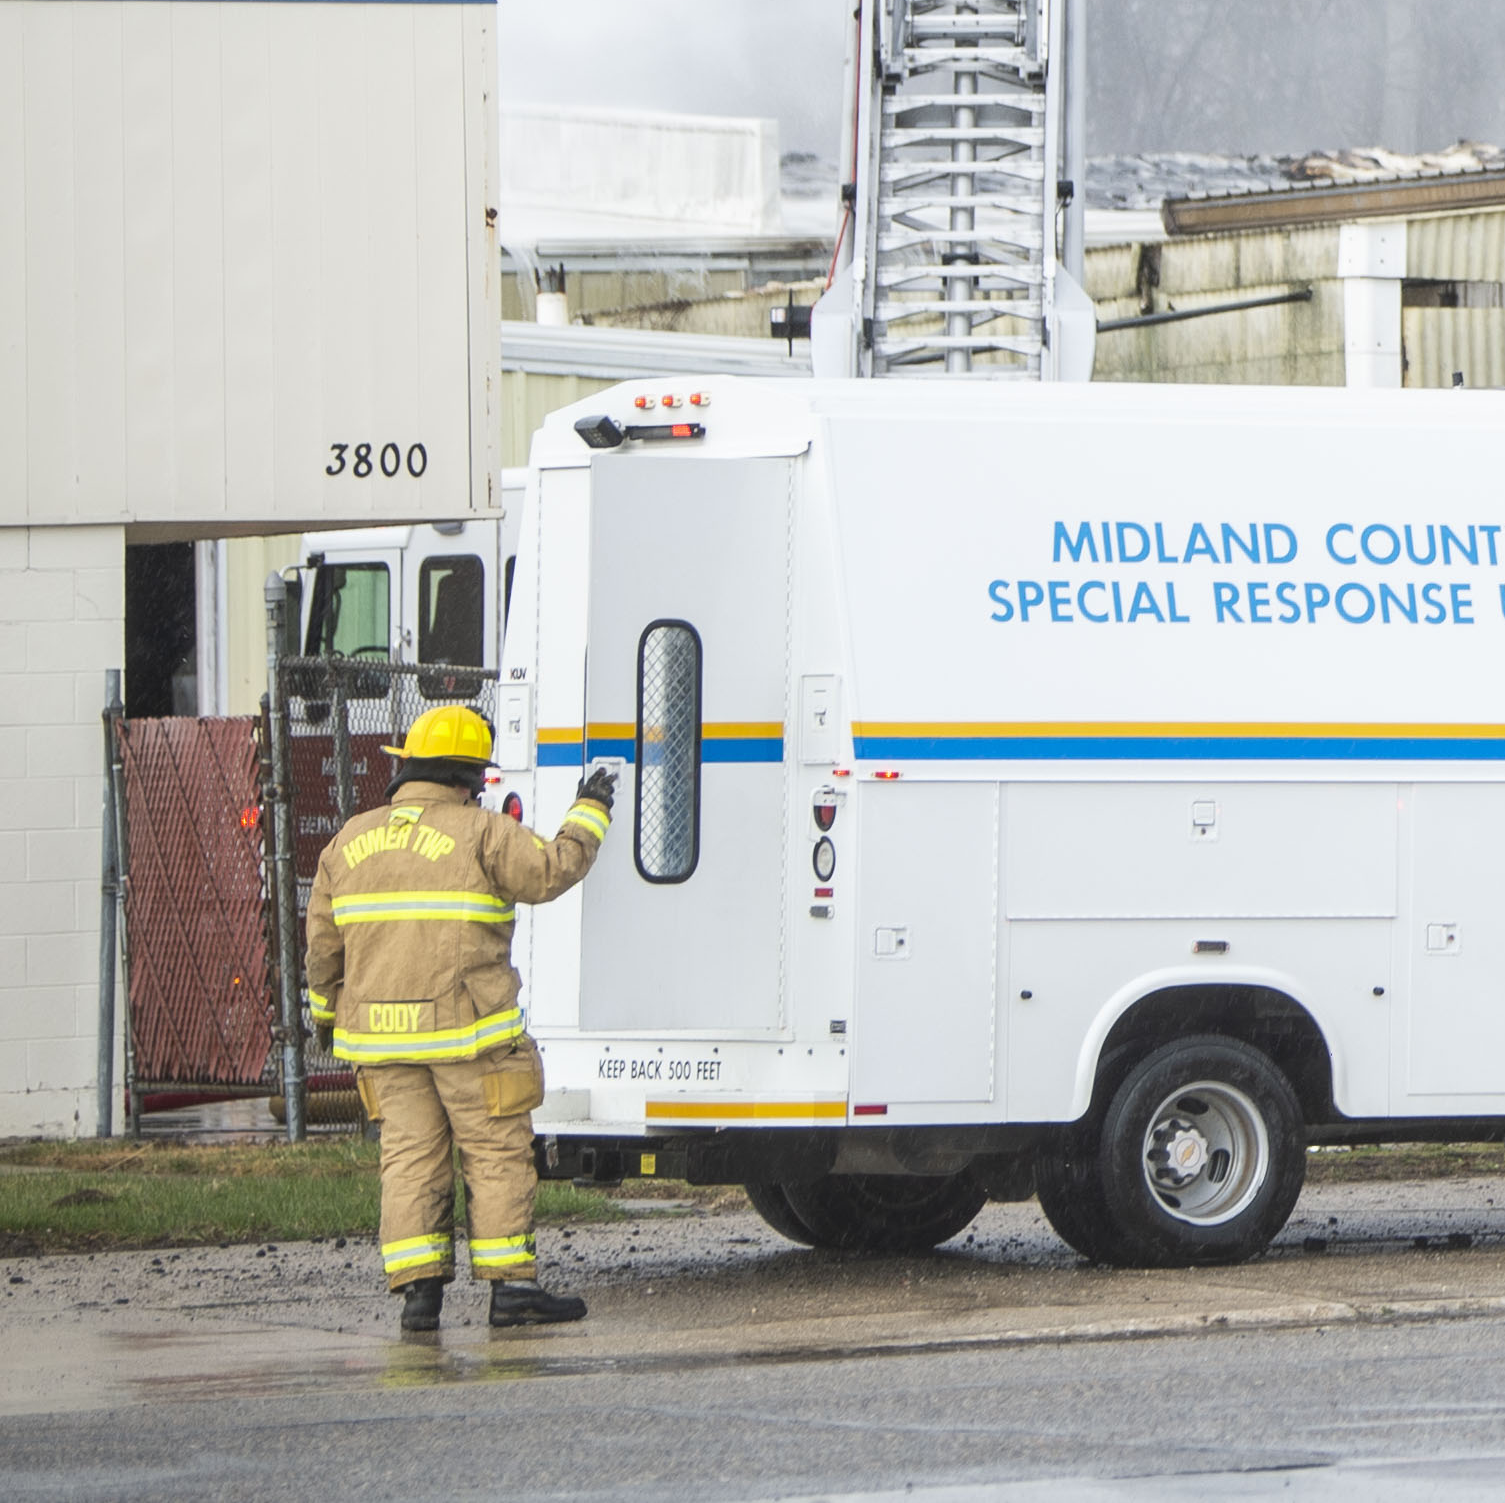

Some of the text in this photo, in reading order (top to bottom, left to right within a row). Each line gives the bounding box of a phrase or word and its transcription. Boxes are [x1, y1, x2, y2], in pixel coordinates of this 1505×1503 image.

[325, 442, 428, 478] 3800
[1053, 520, 1299, 565] MIDLAND
[987, 579, 1191, 624] SPECIAL
[1212, 580, 1475, 625] RESPONSE
[342, 823, 456, 870] HOMER TWP
[369, 1003, 421, 1033] CODY
[599, 1059, 722, 1080] KEEP BACK 500 FEET
